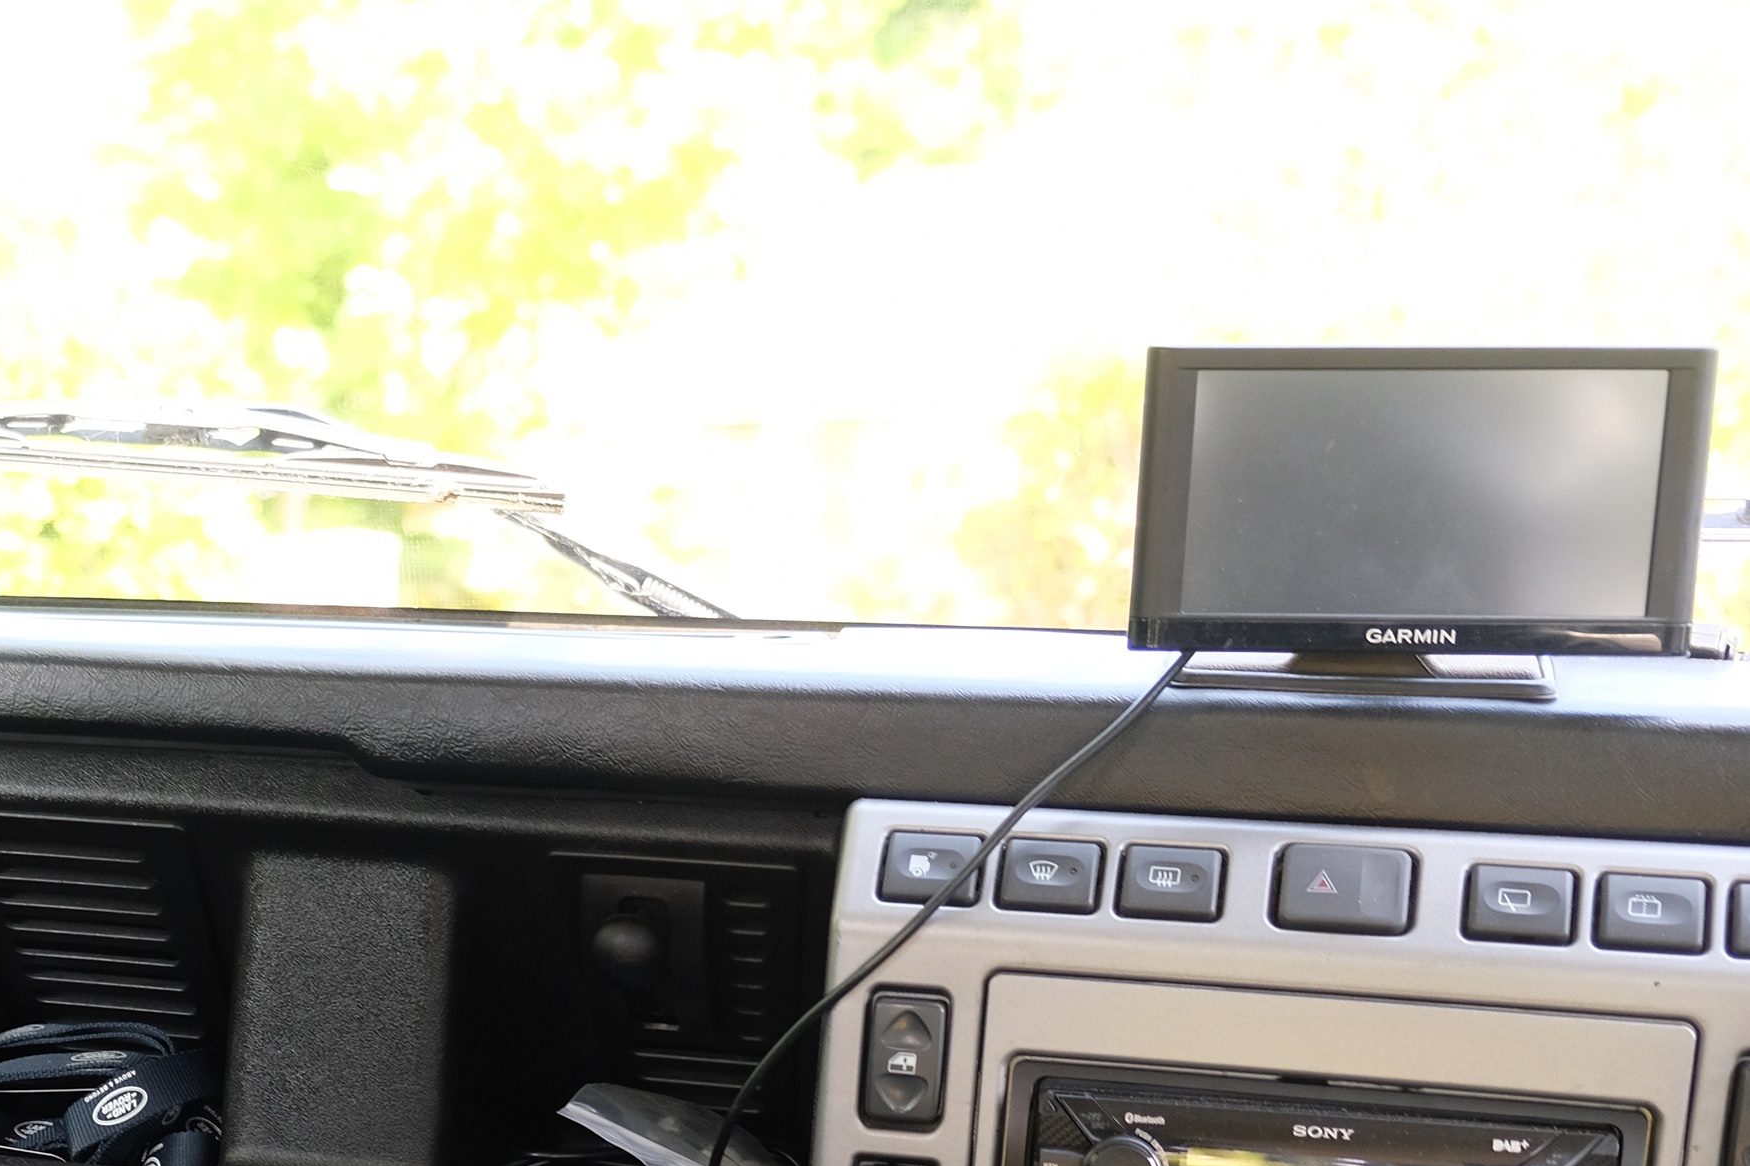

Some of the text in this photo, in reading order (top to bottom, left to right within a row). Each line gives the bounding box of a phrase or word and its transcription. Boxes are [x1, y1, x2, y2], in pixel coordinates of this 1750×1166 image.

[1365, 628, 1456, 645] GARMIN
[114, 1069, 137, 1085] ABOVE
[84, 1086, 109, 1103] BEYOND
[101, 1091, 131, 1115] ROVER
[109, 1097, 139, 1119] LAND
[1134, 1112, 1166, 1125] Bluetooth
[1292, 1124, 1355, 1141] SONY
[1492, 1138, 1531, 1154] DAB+
